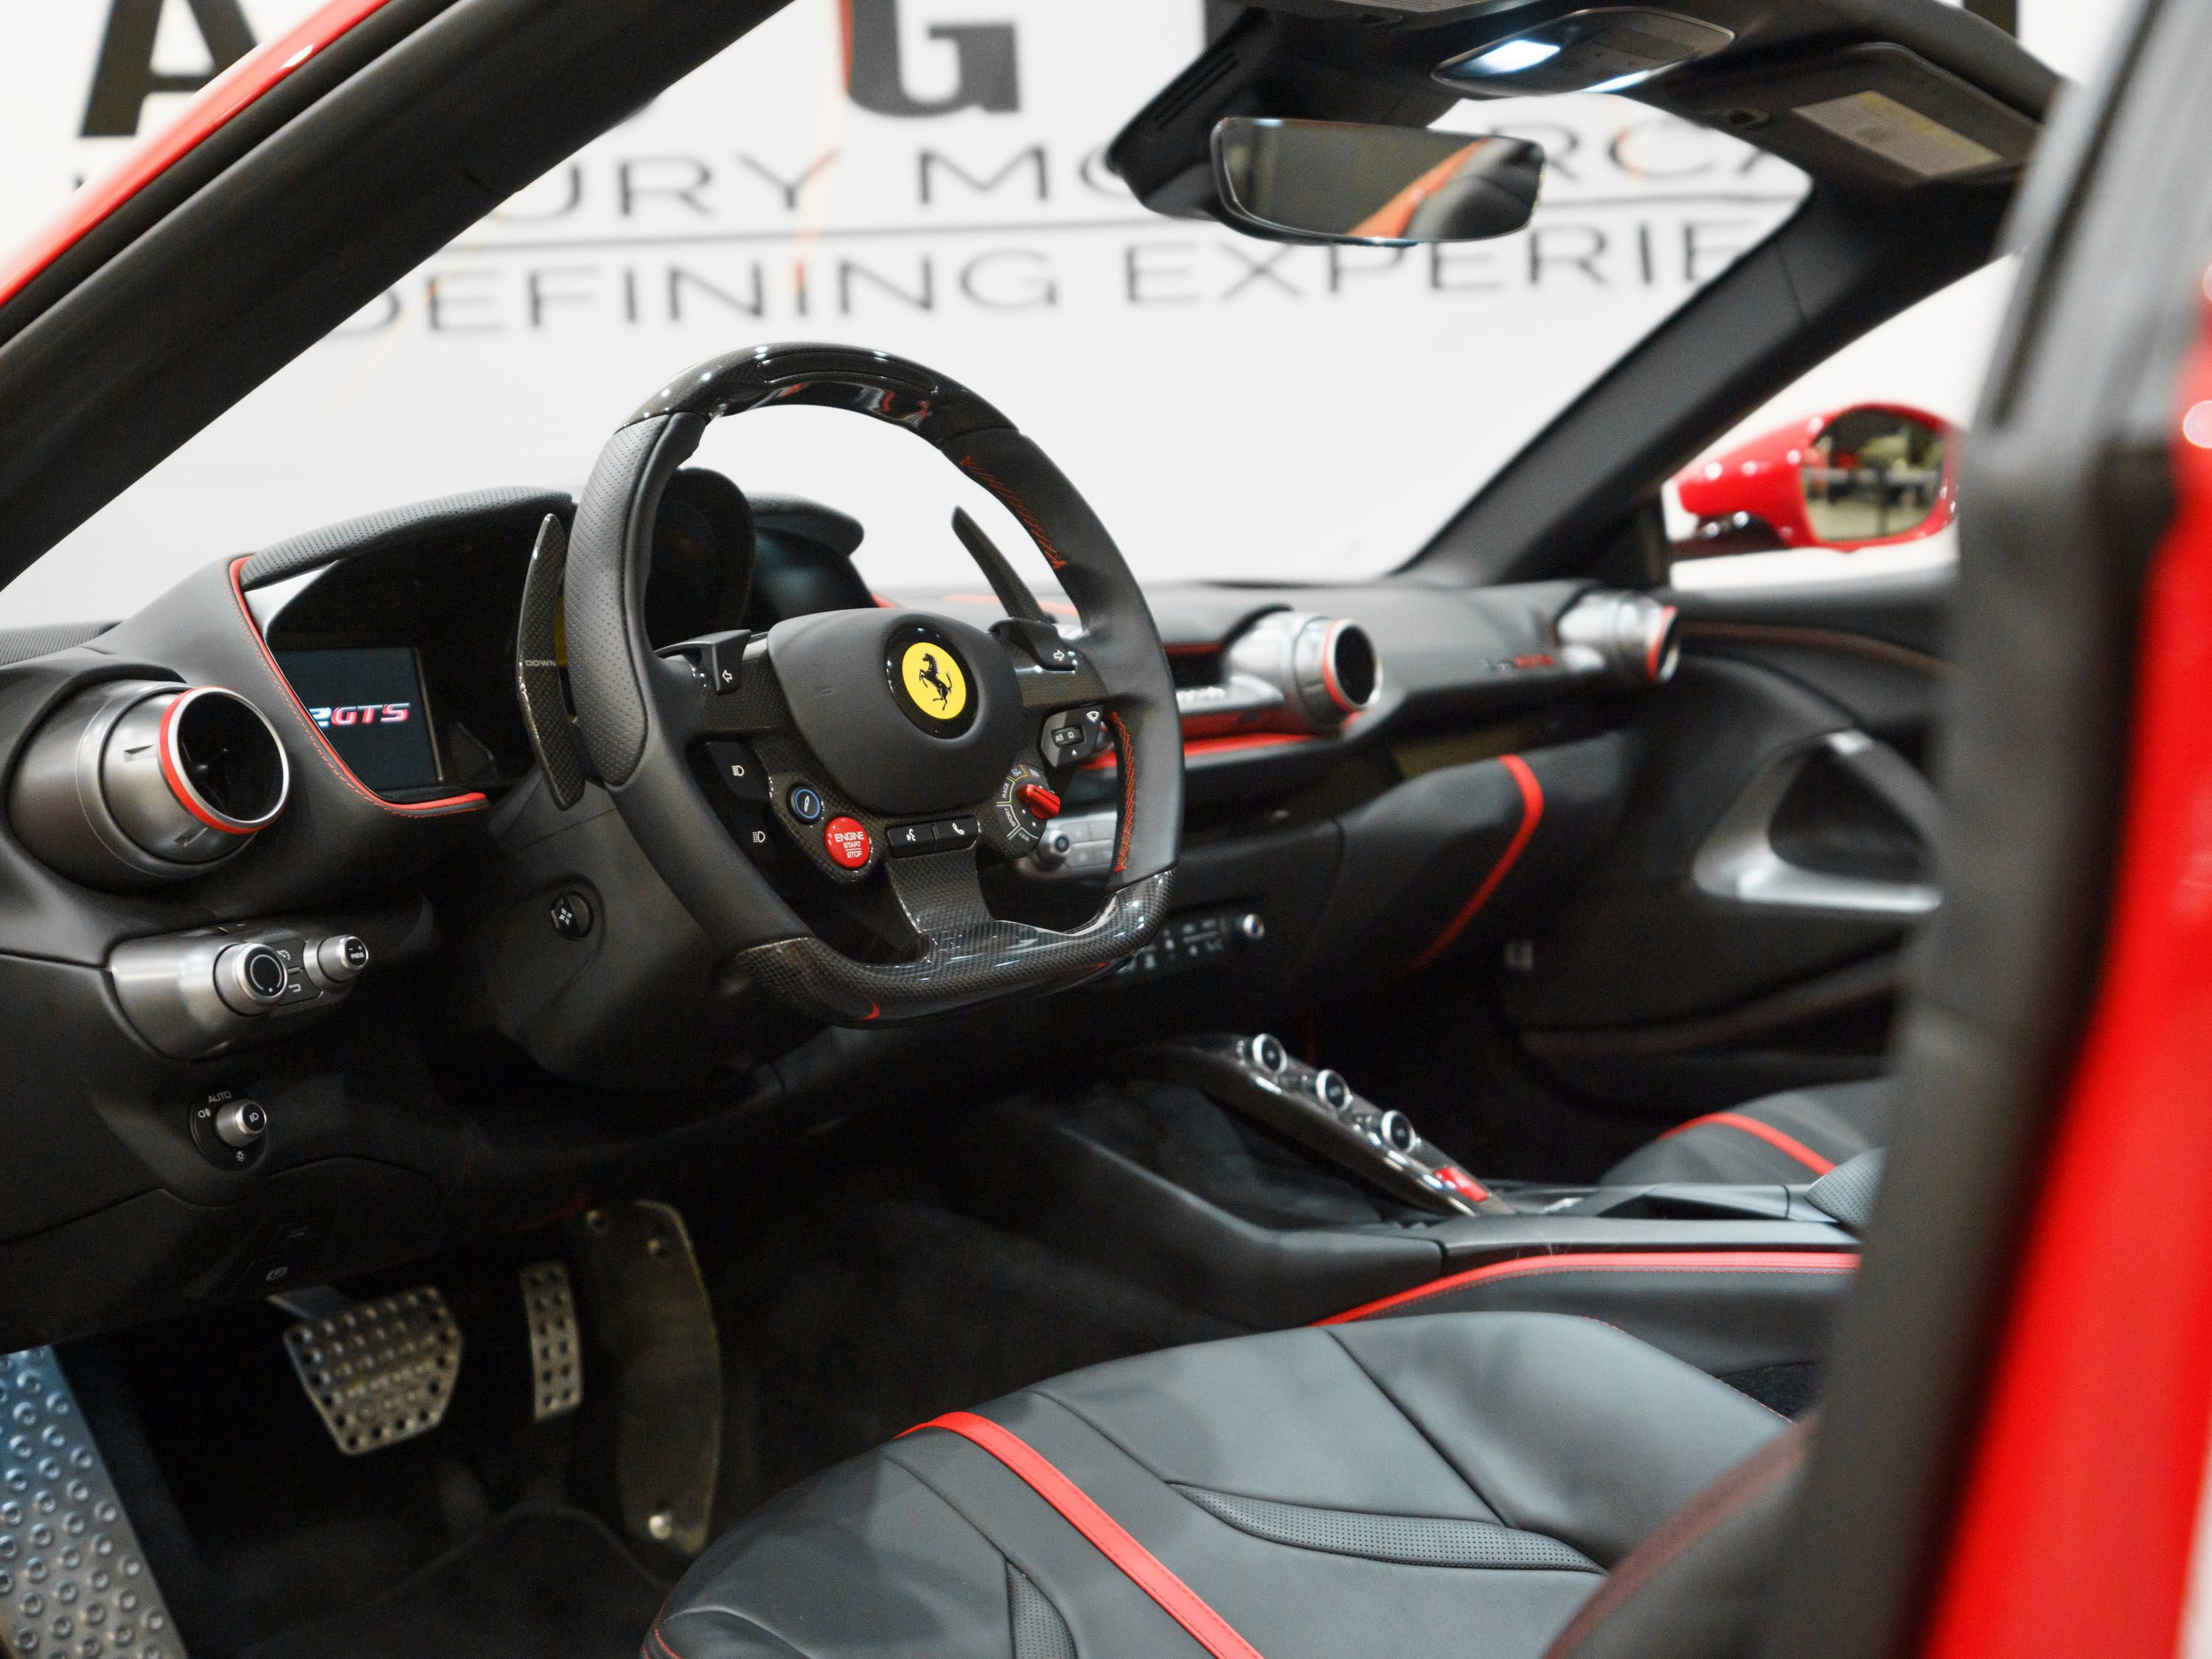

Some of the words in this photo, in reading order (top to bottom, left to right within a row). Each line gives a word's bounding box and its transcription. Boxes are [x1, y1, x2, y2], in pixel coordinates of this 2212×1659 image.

[308, 703, 411, 728] 2GTS
[1004, 807, 1018, 827] SPORT
[834, 831, 864, 843] ENGINE
[843, 841, 861, 849] START
[846, 850, 862, 859] STOP
[208, 1091, 232, 1104] AUTO
